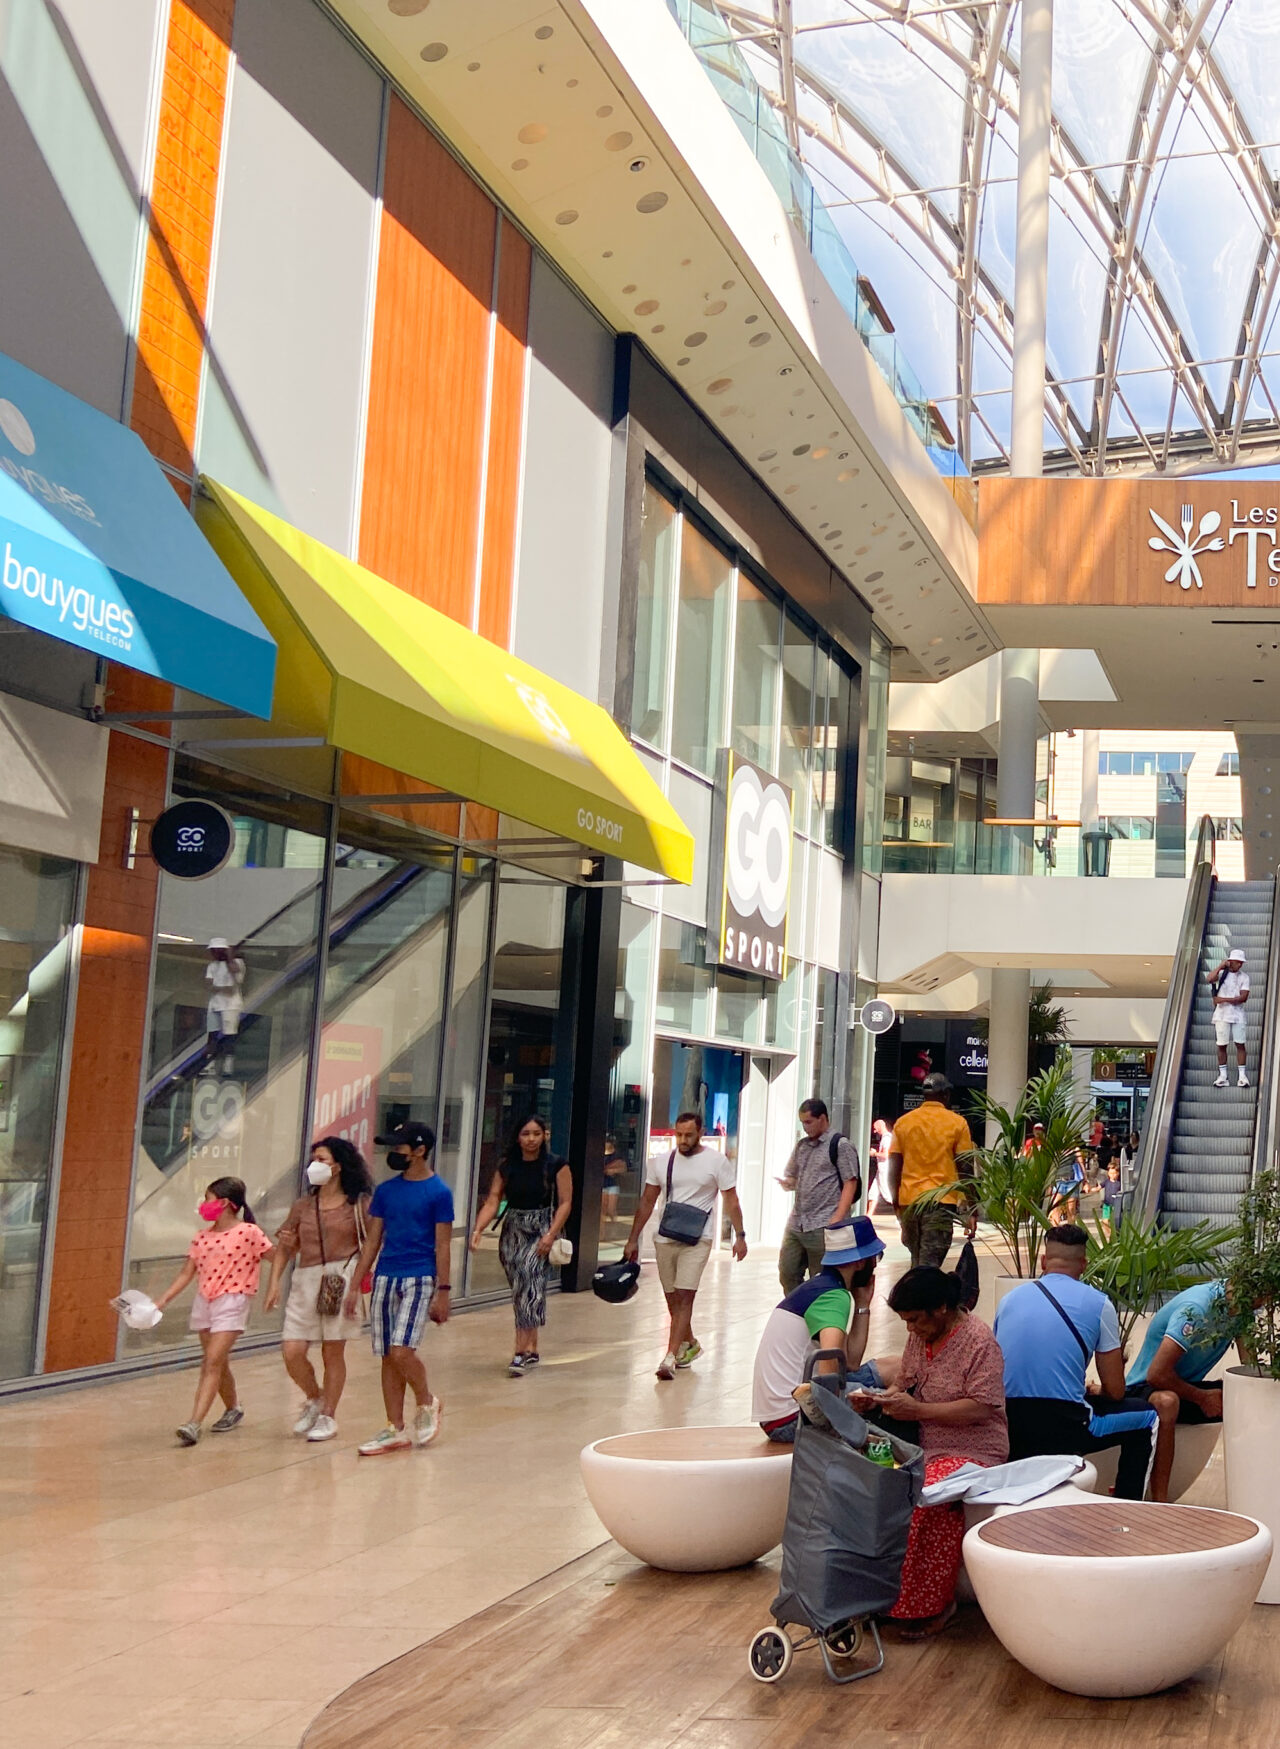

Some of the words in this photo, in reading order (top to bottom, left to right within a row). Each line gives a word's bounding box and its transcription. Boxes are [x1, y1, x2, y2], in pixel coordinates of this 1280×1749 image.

[1230, 500, 1278, 523] Les
[3, 542, 134, 638] bouygues
[87, 625, 132, 652] TELECOM
[577, 807, 594, 831] GO
[595, 815, 624, 844] SPORT
[913, 816, 931, 830] BAR
[728, 772, 790, 921] GO
[725, 926, 784, 976] SPORT
